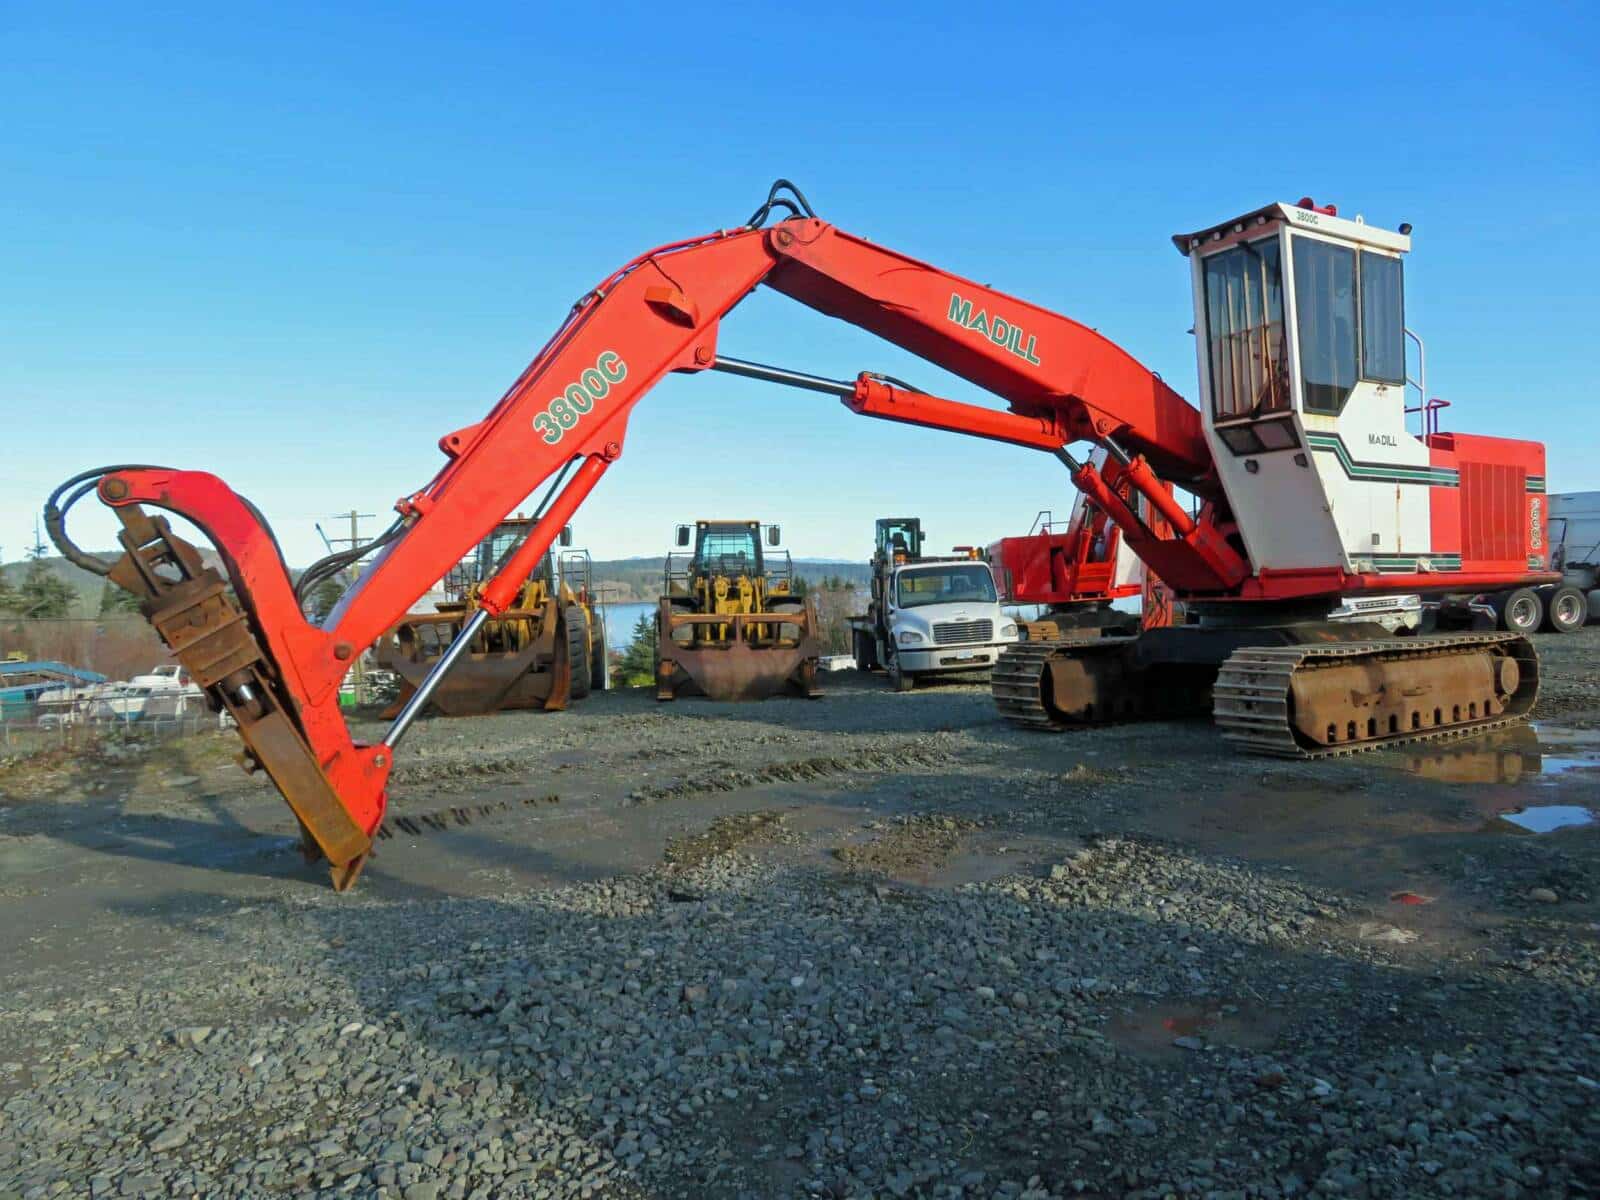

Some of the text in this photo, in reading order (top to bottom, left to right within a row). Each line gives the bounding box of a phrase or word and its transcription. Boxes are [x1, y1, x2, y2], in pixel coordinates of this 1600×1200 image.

[947, 292, 1041, 367] MADILL
[532, 350, 628, 445] 3800C
[1368, 433, 1398, 447] MADILL
